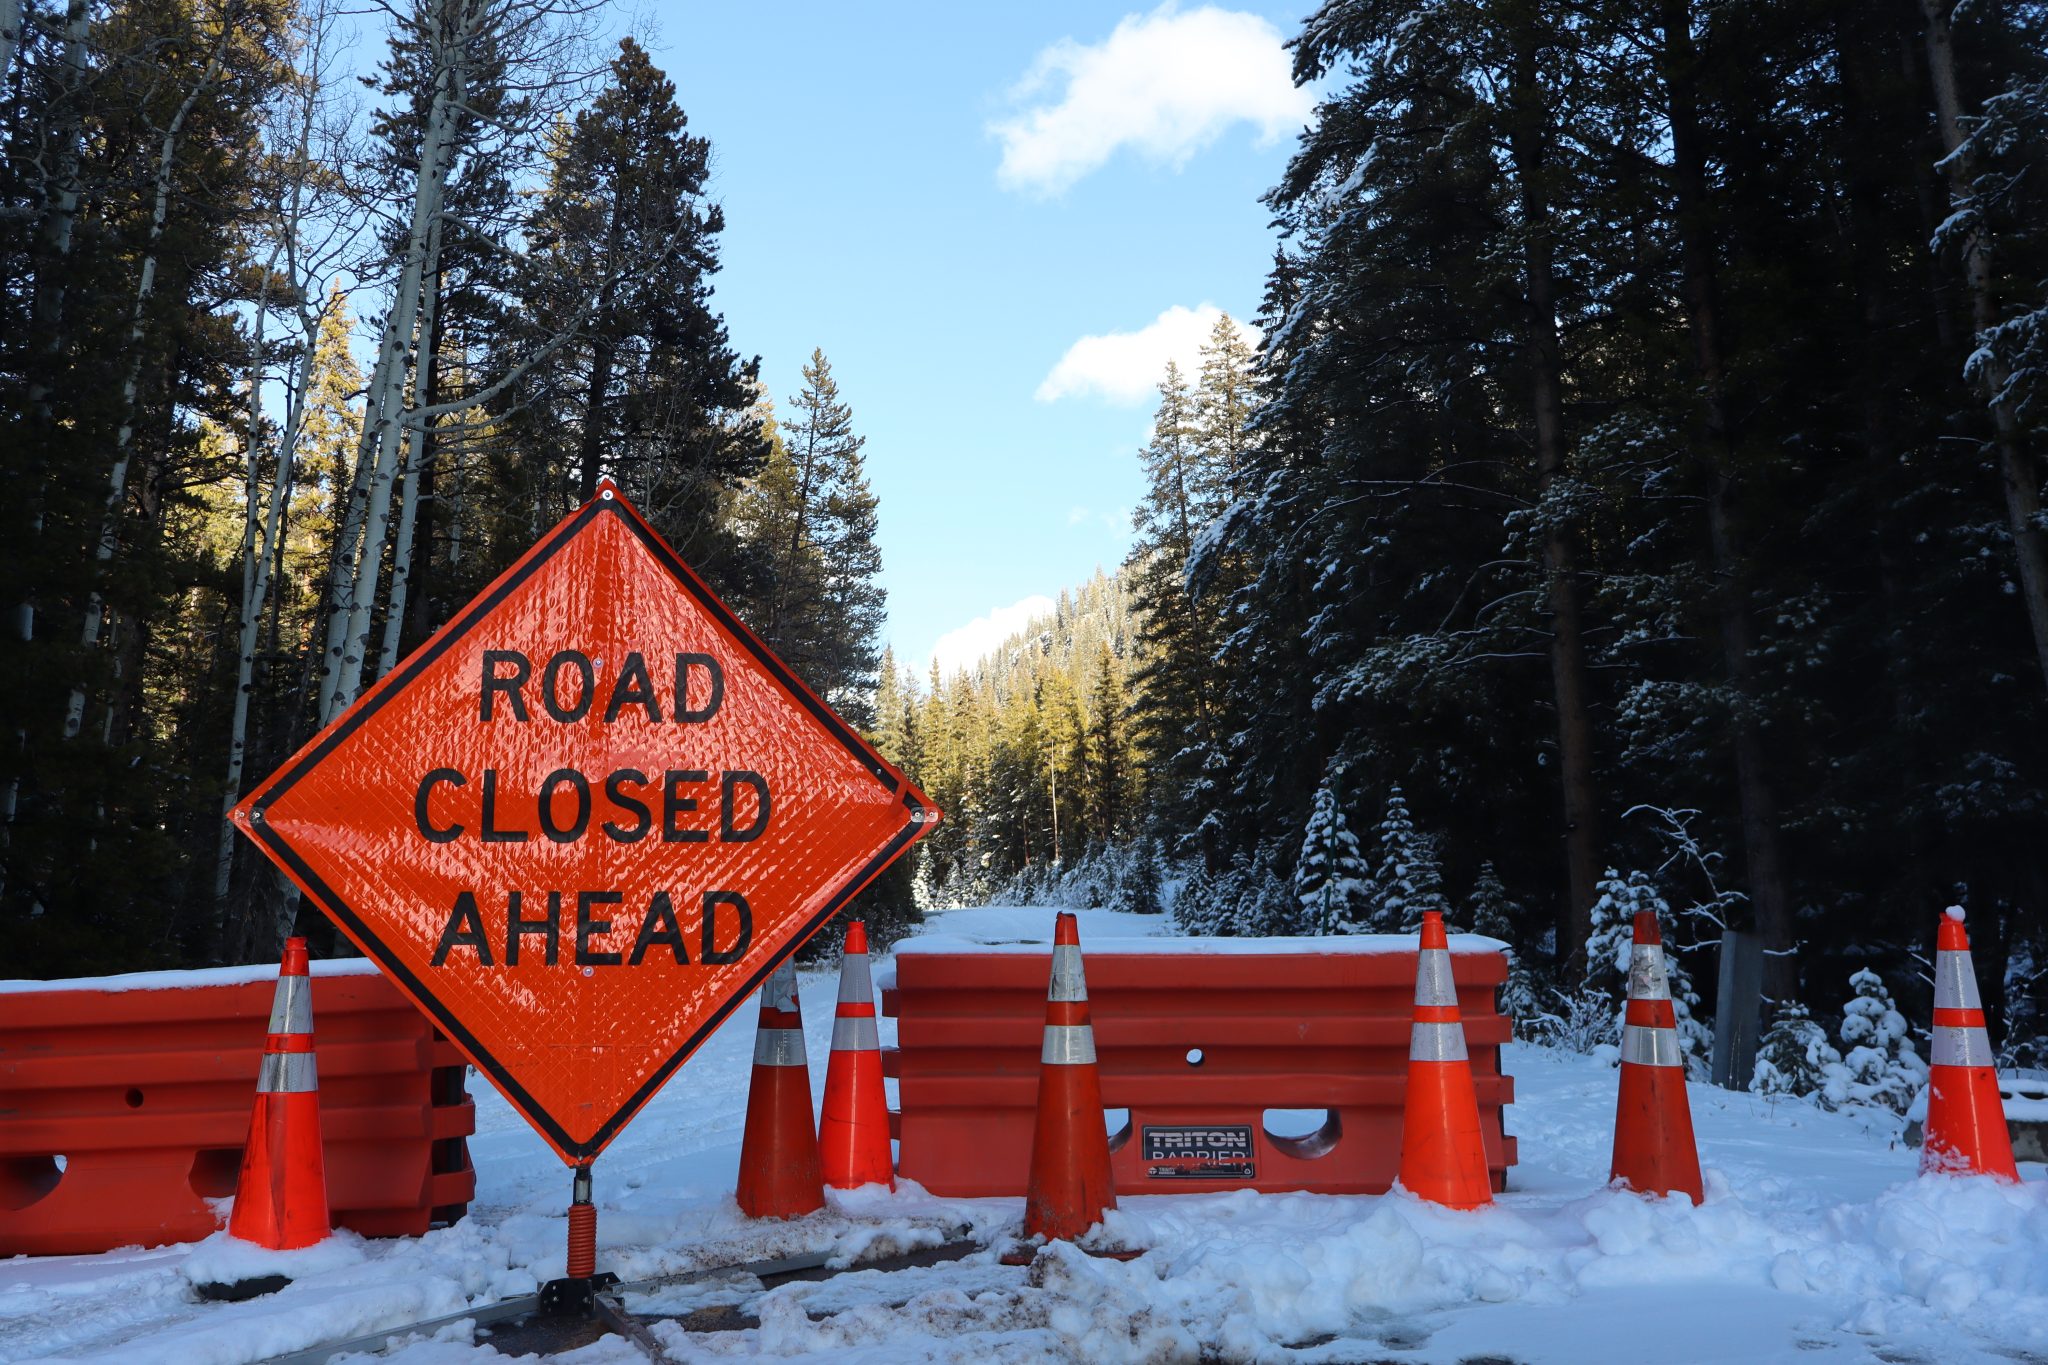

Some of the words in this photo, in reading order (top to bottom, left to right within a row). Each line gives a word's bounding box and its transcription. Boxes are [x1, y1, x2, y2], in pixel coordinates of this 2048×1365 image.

[479, 649, 725, 724] ROAD
[414, 767, 772, 844] CLOSED
[430, 890, 753, 967] AHEAD
[1149, 1131, 1247, 1148] TRITON
